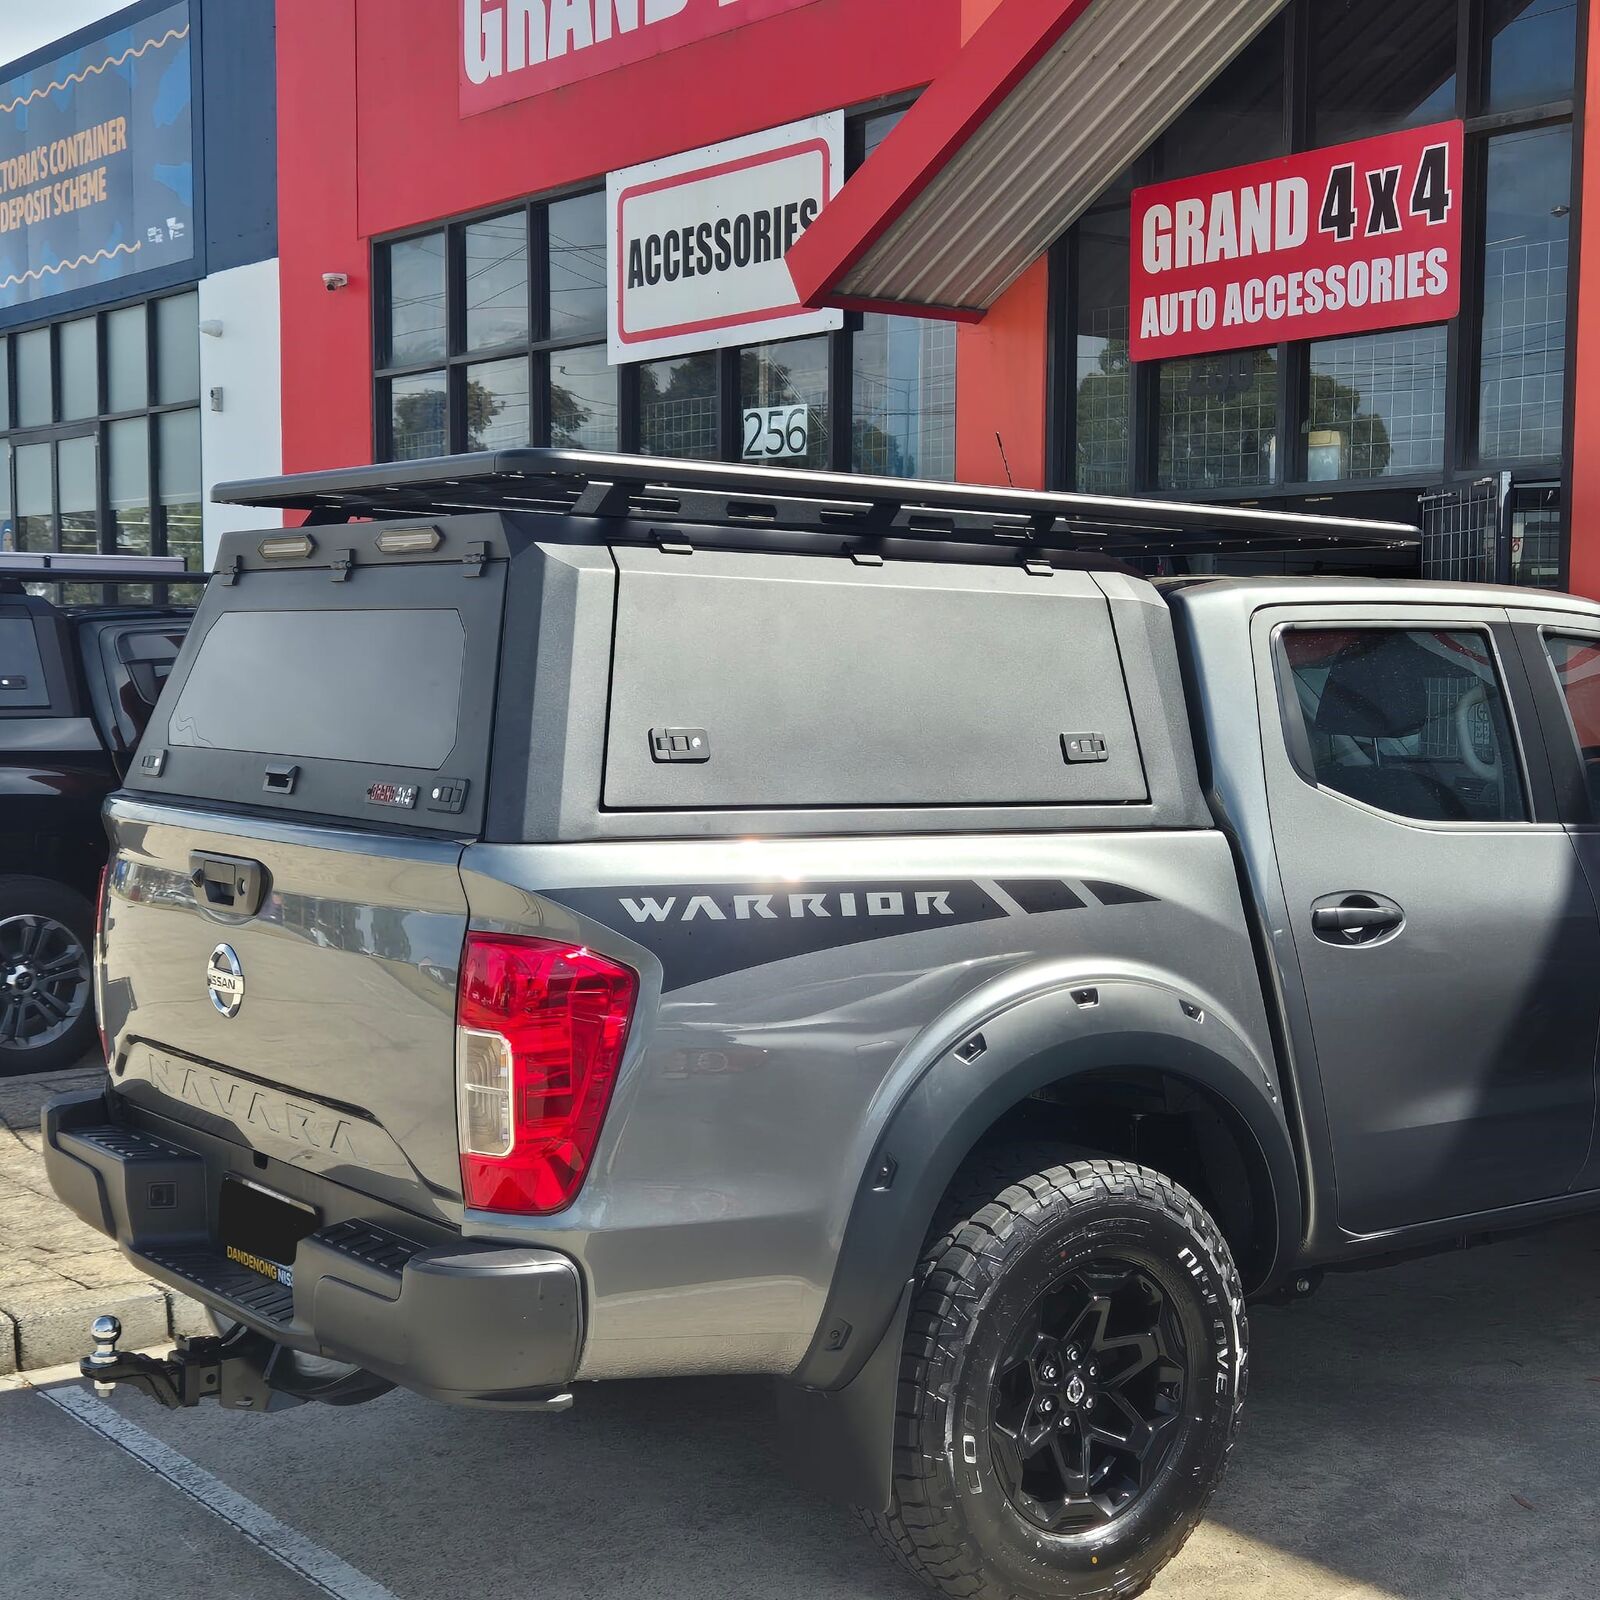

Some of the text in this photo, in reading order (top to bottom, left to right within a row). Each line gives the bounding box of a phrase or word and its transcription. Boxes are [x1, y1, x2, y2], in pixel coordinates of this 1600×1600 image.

[463, 0, 688, 84] GRA
[0, 116, 127, 194] TORIA'S CONTAINER
[0, 166, 107, 233] DEPOSIT SCHEME
[1142, 176, 1309, 274] GRAND
[1140, 247, 1448, 339] AUTO ACCESSORIES
[744, 408, 806, 456] 256
[618, 891, 954, 922] WARRIOR
[149, 1053, 369, 1165] NAVARA
[226, 1245, 277, 1280] DANDENONG
[277, 1268, 293, 1287] NIS
